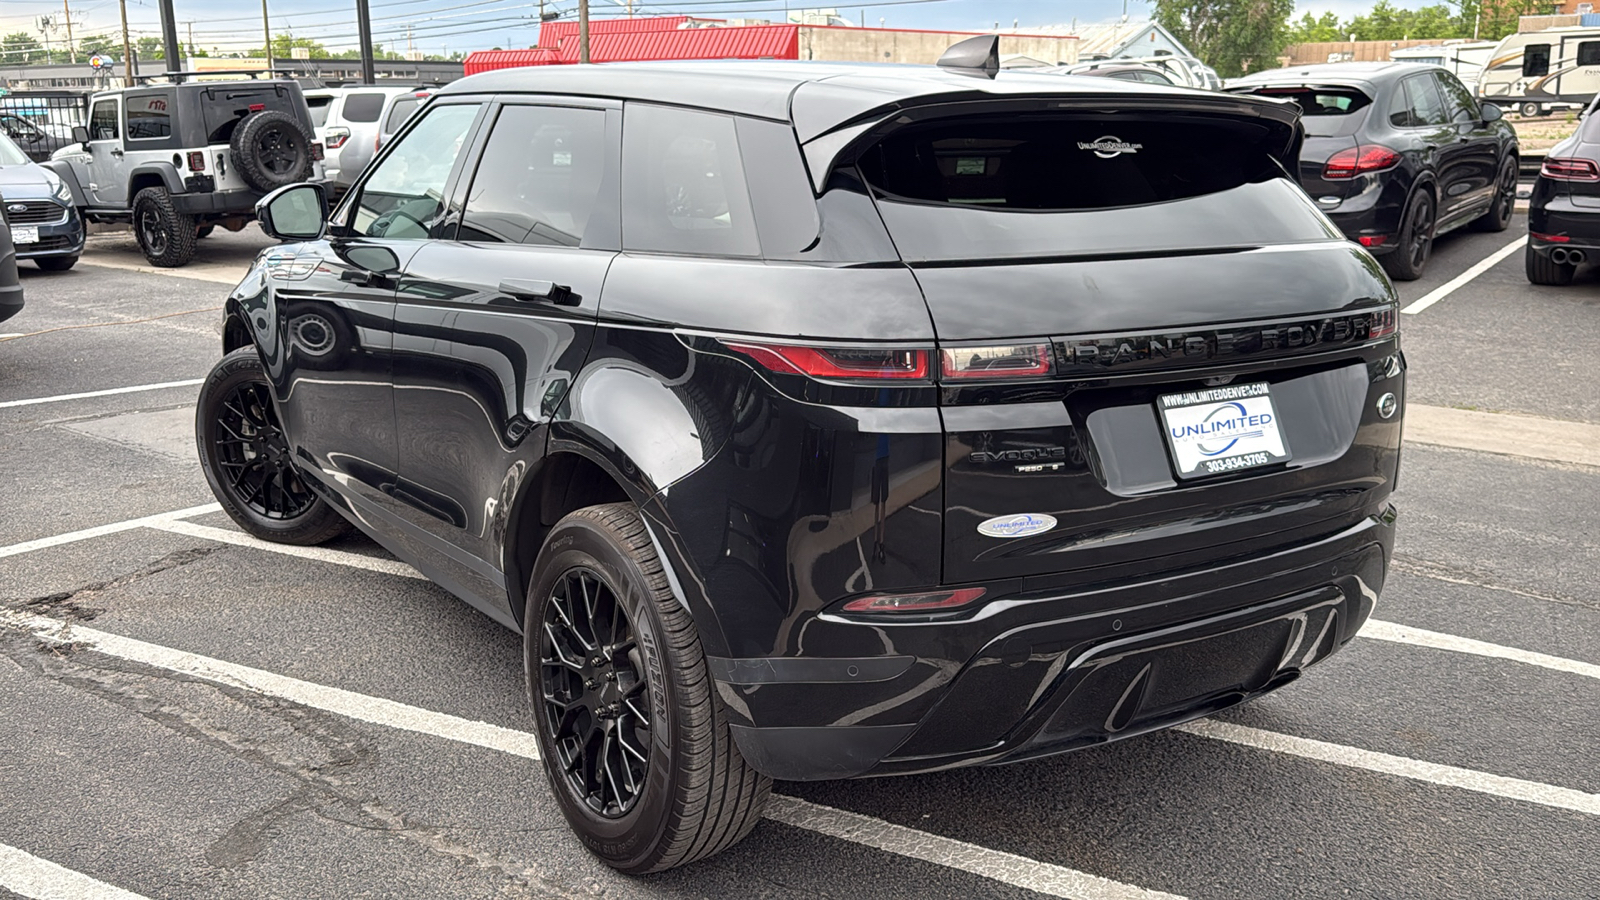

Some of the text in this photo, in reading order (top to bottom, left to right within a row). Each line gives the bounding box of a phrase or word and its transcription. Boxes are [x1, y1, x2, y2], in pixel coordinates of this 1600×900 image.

[1074, 333, 1235, 364] RANGE
[1172, 413, 1272, 438] UNLIMITED
[1213, 428, 1248, 437] SALES
[969, 446, 1066, 462] EVOQUE
[1205, 453, 1268, 473] 303-934-3705
[992, 519, 1043, 529] UNLIMITED
[645, 644, 667, 724] FUZION
